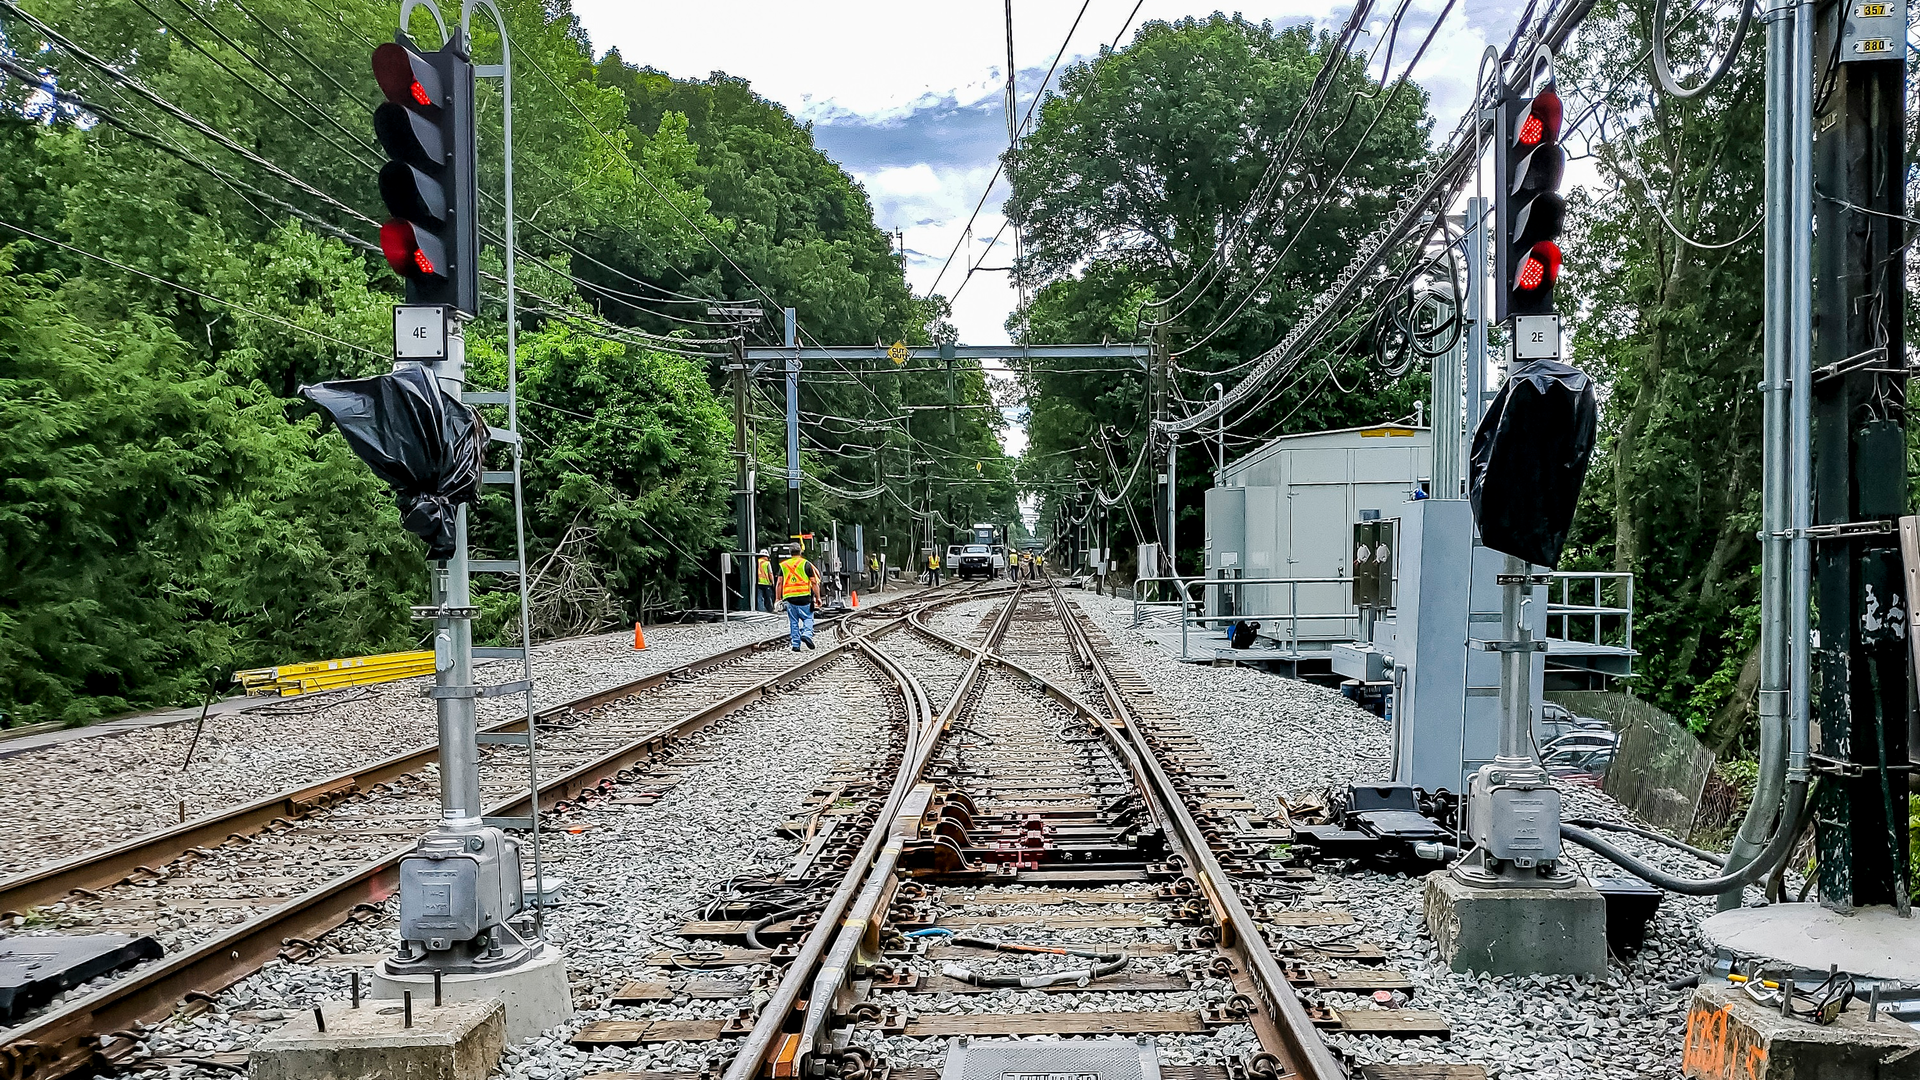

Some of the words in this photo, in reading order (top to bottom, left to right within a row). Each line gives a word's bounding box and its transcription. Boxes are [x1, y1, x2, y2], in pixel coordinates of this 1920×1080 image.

[1864, 5, 1885, 16] 357
[1864, 40, 1885, 51] 880
[412, 326, 427, 339] 4E
[1531, 331, 1544, 343] 2E
